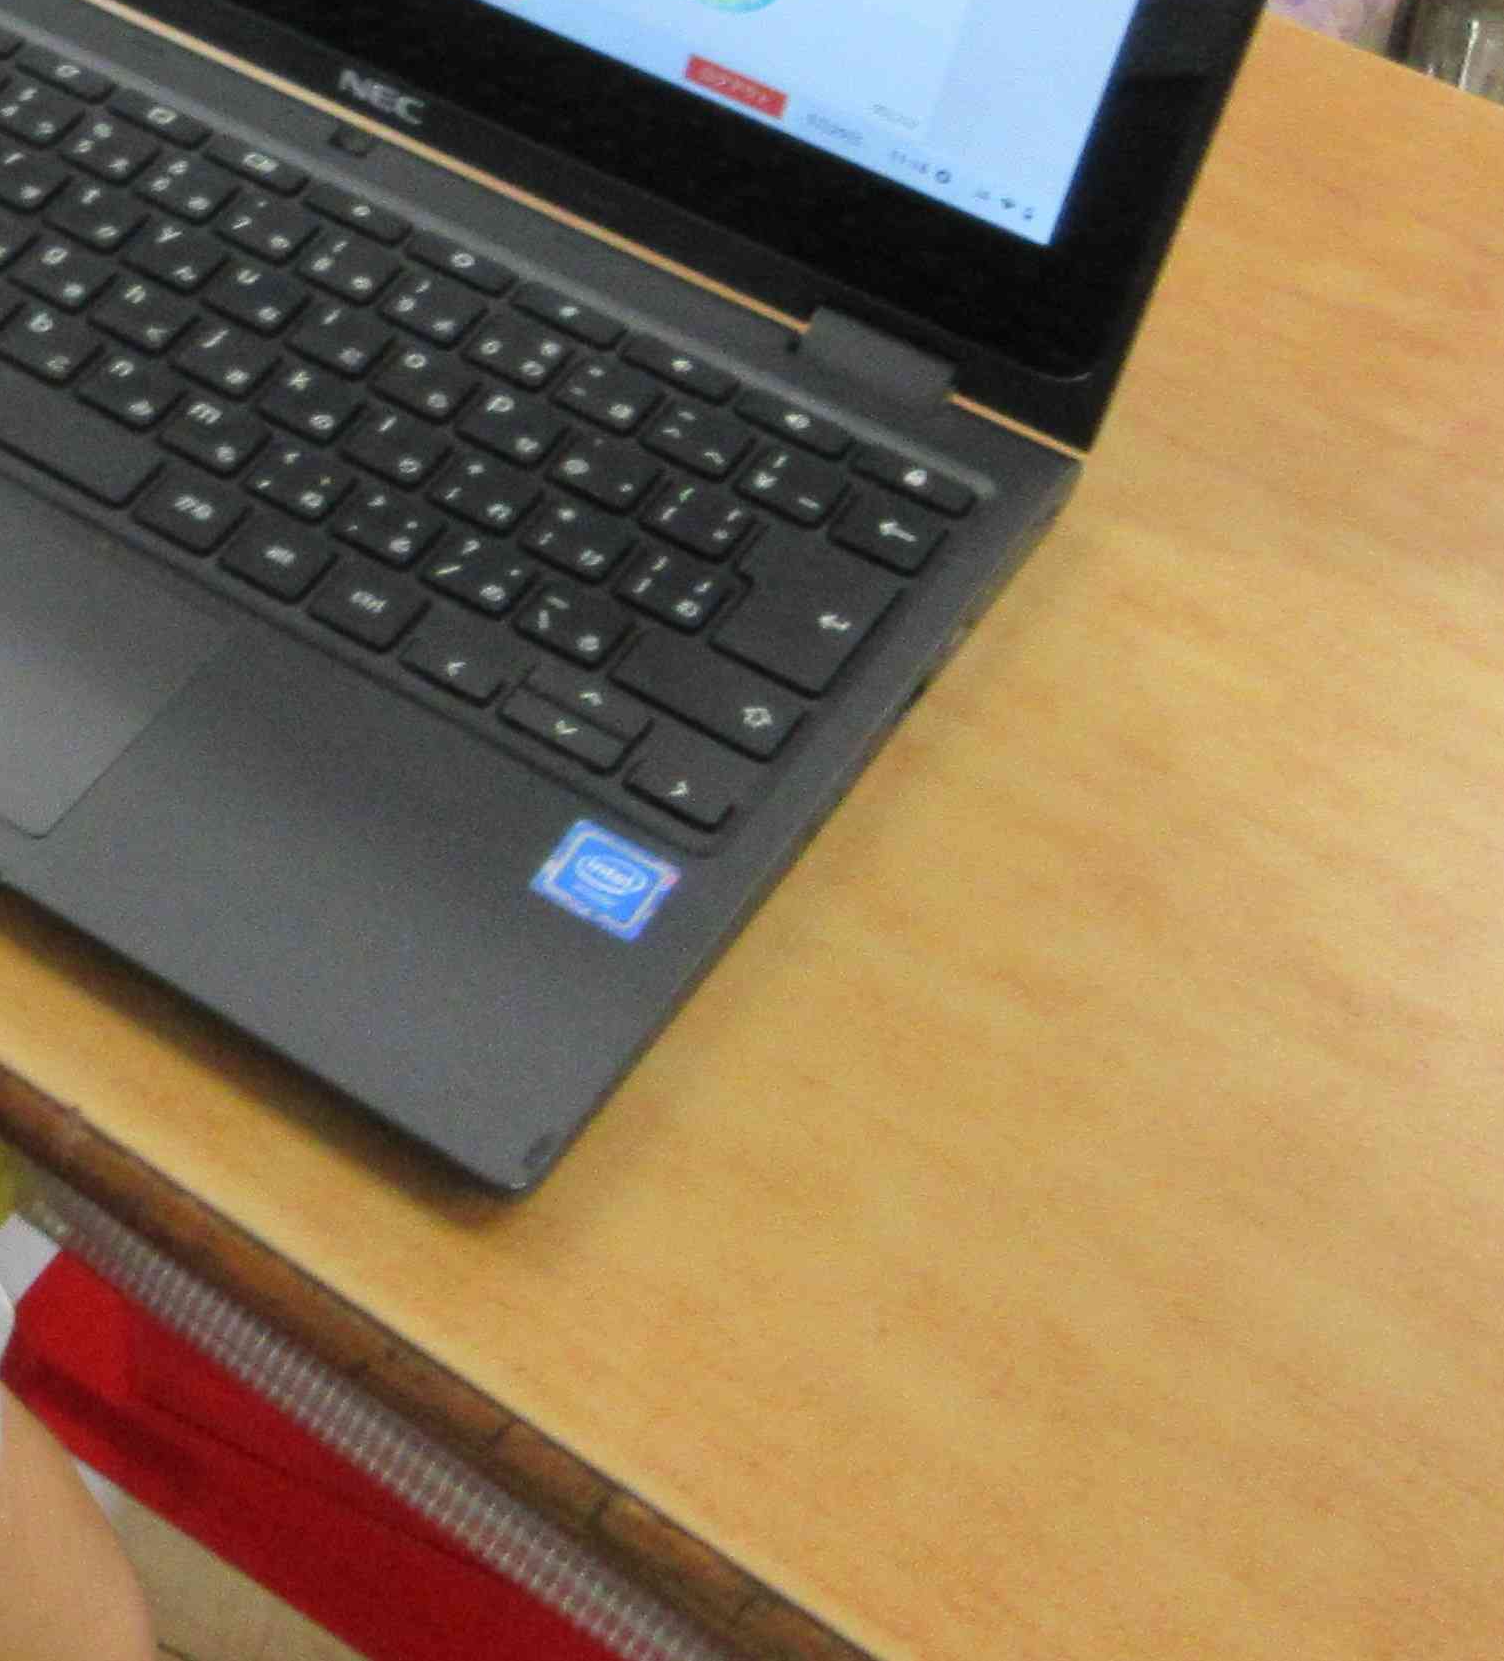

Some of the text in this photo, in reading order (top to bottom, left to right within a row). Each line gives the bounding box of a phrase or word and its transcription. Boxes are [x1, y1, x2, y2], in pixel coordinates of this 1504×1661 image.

[337, 67, 426, 126] NEC
[188, 402, 223, 424] m
[486, 395, 514, 413] p
